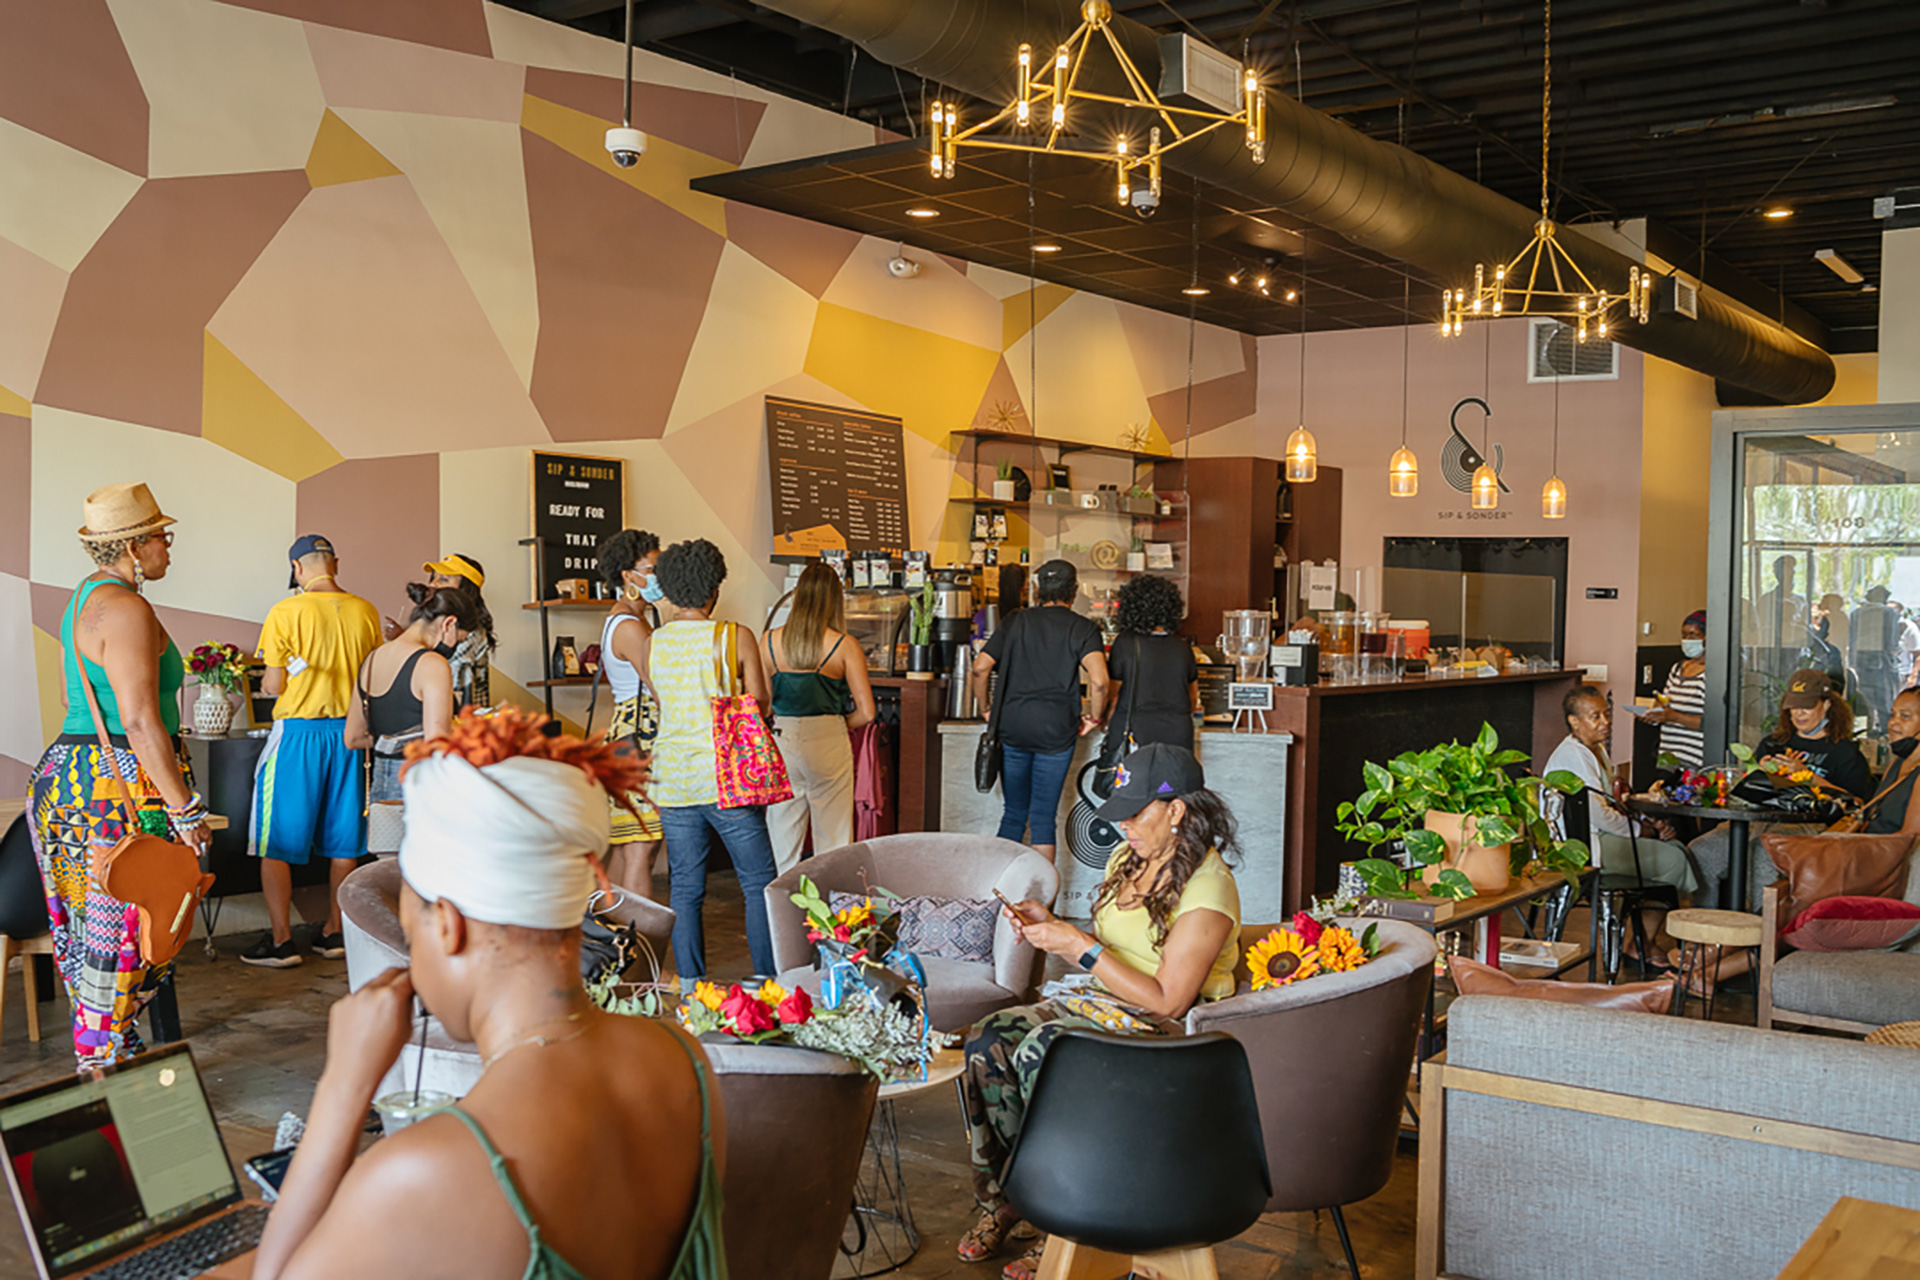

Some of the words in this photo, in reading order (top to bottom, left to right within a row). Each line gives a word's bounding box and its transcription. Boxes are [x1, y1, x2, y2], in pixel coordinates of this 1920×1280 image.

[547, 462, 563, 475] SIP
[569, 465, 575, 477] &
[581, 466, 615, 480] SONDER
[549, 504, 580, 517] READY
[585, 506, 605, 519] FOR
[1438, 511, 1454, 519] SIP
[565, 533, 597, 547] THAT
[564, 557, 598, 570] DRIP
[1062, 891, 1082, 901] SIP
